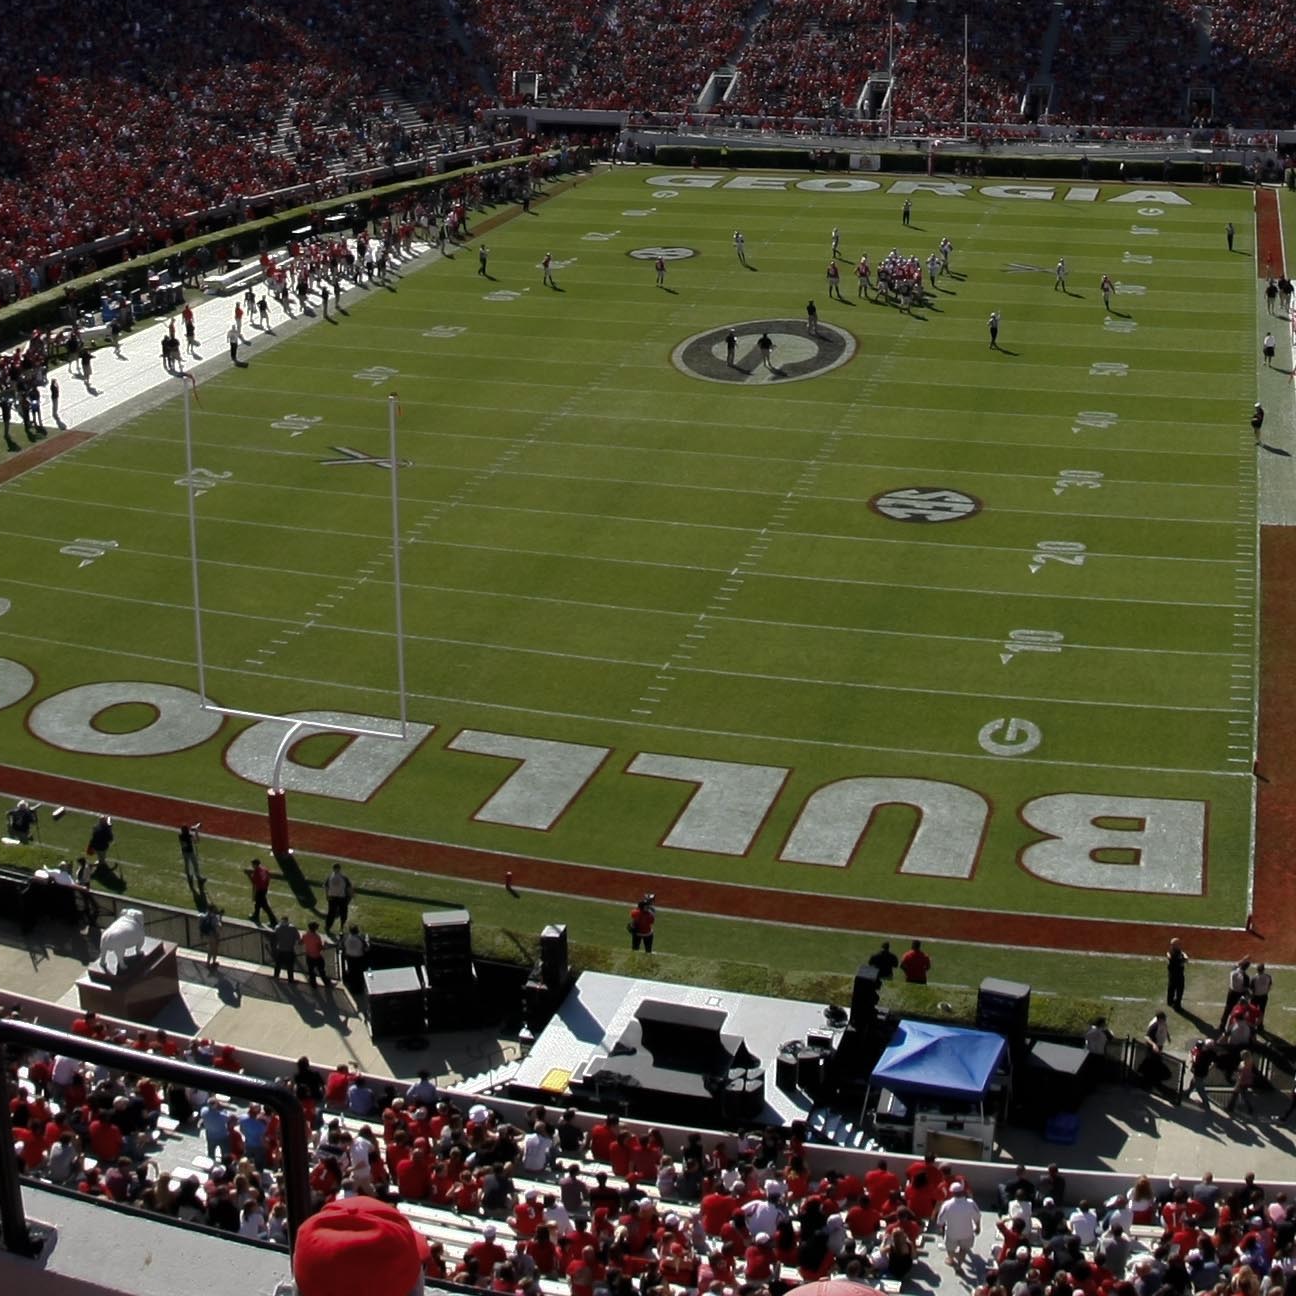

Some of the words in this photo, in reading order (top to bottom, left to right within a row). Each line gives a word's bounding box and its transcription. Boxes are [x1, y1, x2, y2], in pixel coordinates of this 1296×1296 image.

[644, 175, 1193, 205] GEORGIA
[1089, 362, 1129, 376] 50
[1075, 411, 1119, 429] 40
[1055, 470, 1104, 489] 30
[59, 537, 120, 557] 10
[1033, 541, 1087, 566] 20
[1004, 629, 1064, 653] 10
[978, 717, 1042, 756] G
